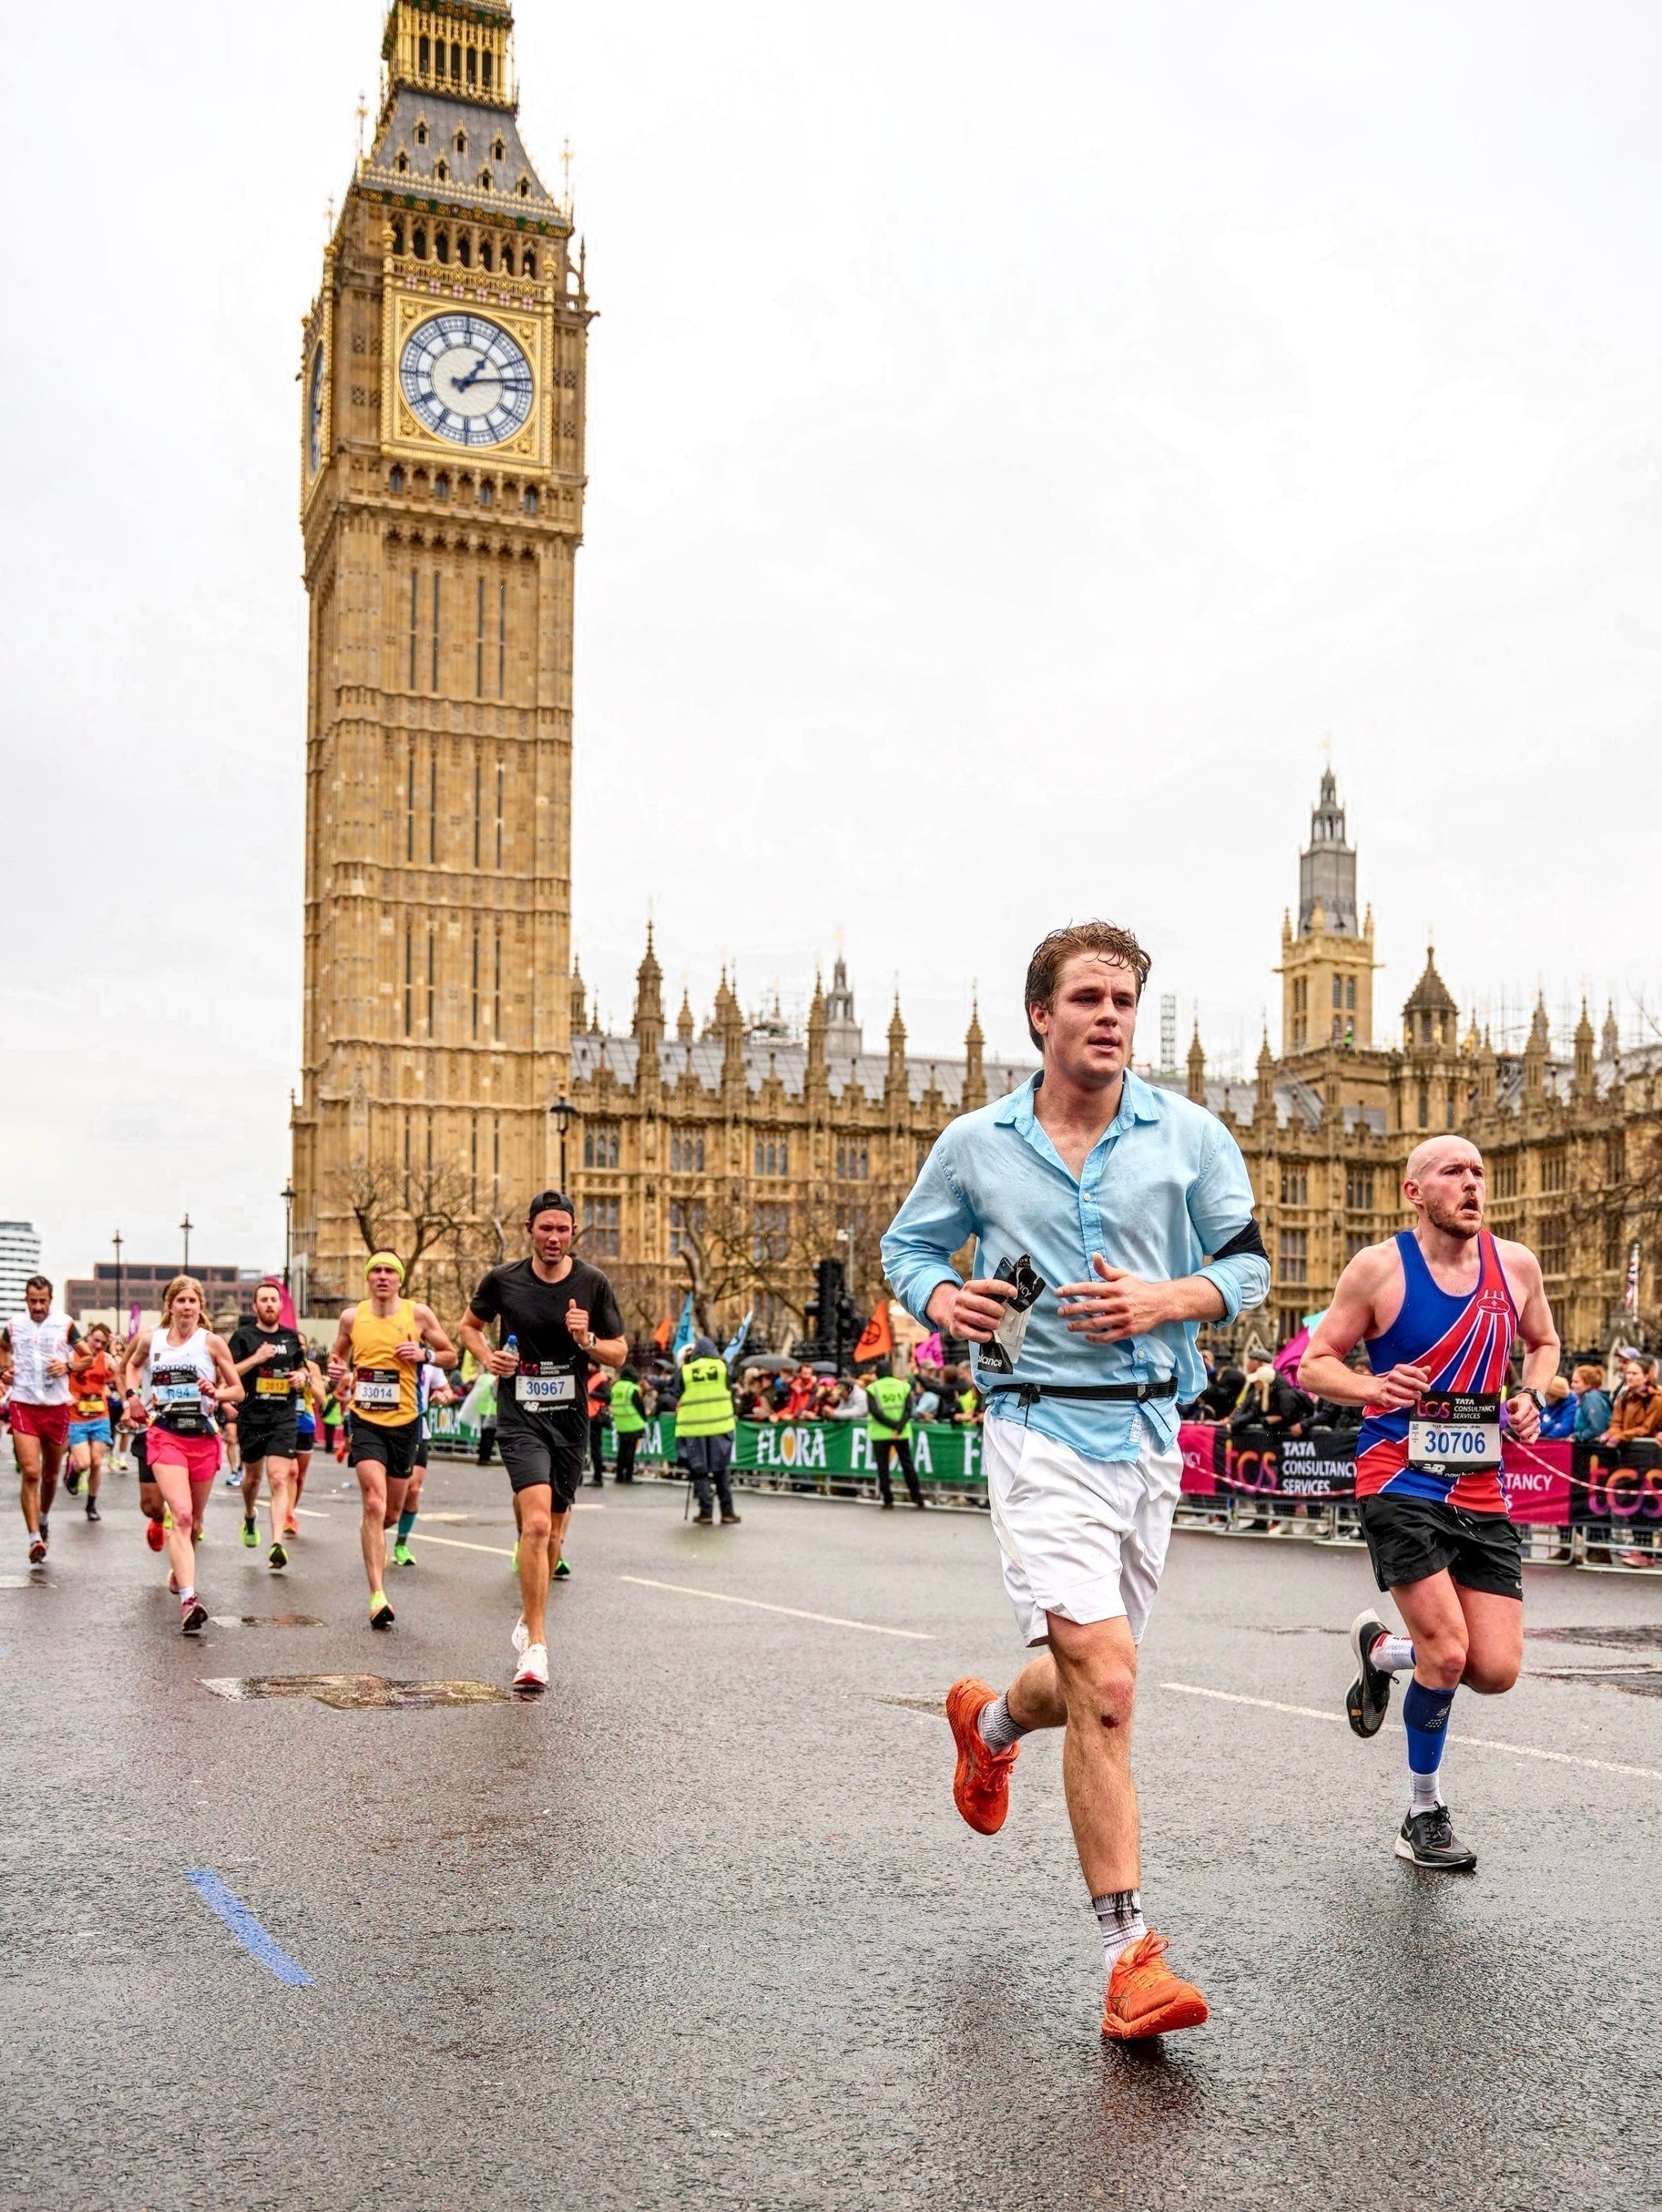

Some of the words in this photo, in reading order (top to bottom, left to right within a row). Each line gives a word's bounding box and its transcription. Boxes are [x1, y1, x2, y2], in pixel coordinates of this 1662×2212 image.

[362, 1387, 393, 1398] 33014
[526, 1381, 565, 1395] 30967
[757, 1426, 827, 1468] FLORA
[1282, 1442, 1316, 1457] TATA
[1424, 1430, 1486, 1454] 30706
[1224, 1439, 1278, 1493] tcs
[1282, 1460, 1358, 1478] CONSULTANCY
[1282, 1479, 1331, 1495] SERVICES
[1504, 1473, 1553, 1492] TANCY
[1588, 1454, 1662, 1519] tcs
